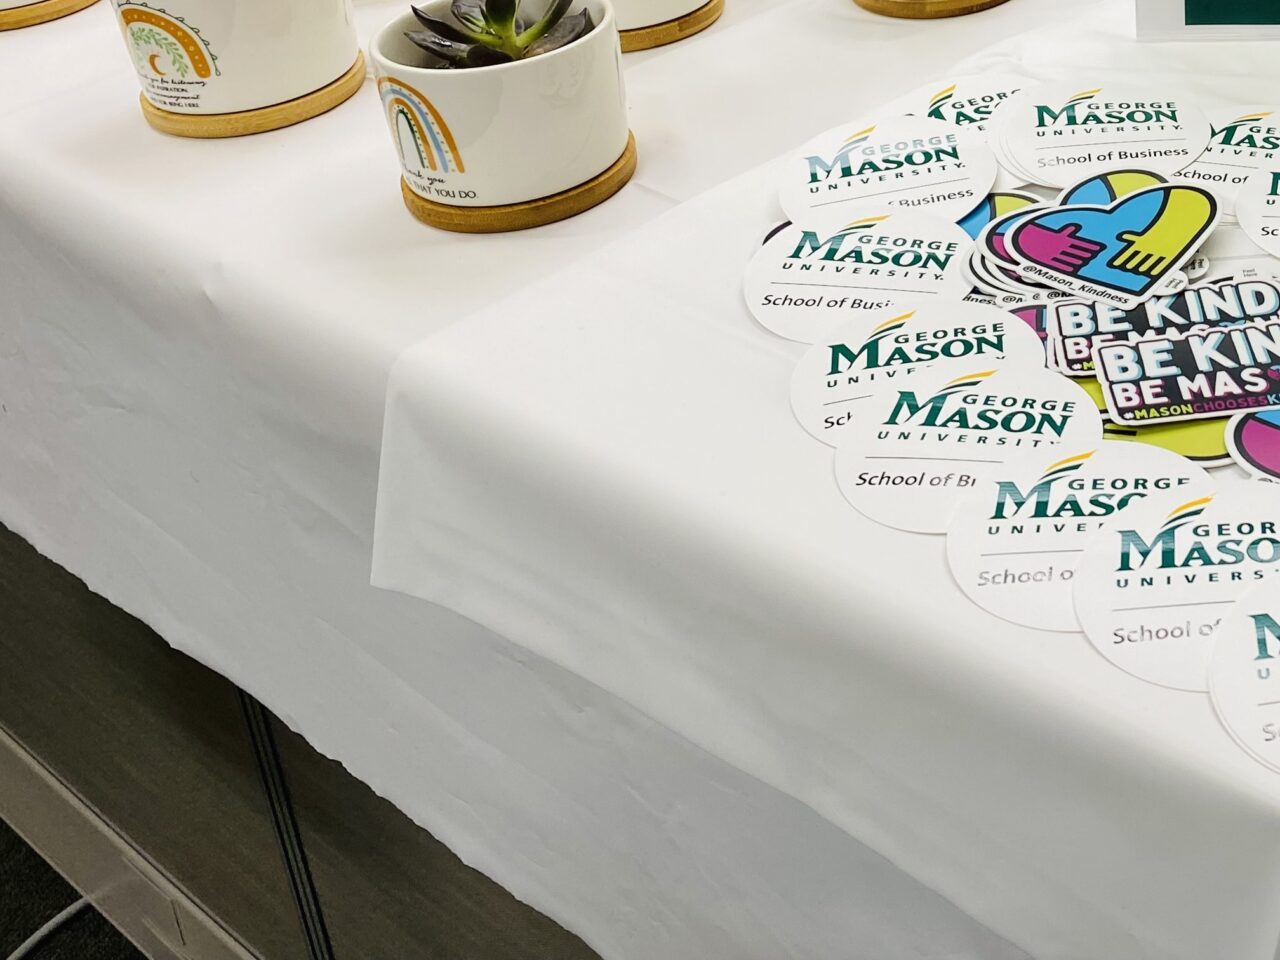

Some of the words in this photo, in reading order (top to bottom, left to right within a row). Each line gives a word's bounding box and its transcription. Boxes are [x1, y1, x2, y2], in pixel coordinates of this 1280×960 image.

[1034, 105, 1179, 128] MASON
[1088, 101, 1176, 111] GEORGE
[862, 134, 957, 157] GEORGE
[804, 144, 960, 184] MASON
[1037, 153, 1093, 169] School
[1097, 150, 1115, 162] of
[1118, 146, 1189, 161] Business
[427, 176, 446, 185] you
[435, 188, 456, 198] YOU
[787, 230, 953, 272] MASON
[858, 235, 958, 252] GEORGE
[1023, 264, 1130, 305] @Mason_Kindness
[761, 294, 824, 308] School
[894, 322, 1005, 344] GEORGE
[826, 333, 1006, 376] MASON
[1100, 340, 1181, 384] BE
[961, 393, 1076, 413] GEORGE
[1110, 381, 1171, 408] BE
[882, 390, 1071, 438] MASON
[856, 471, 926, 487] School
[978, 566, 1053, 587] School
[1113, 620, 1191, 646] School
